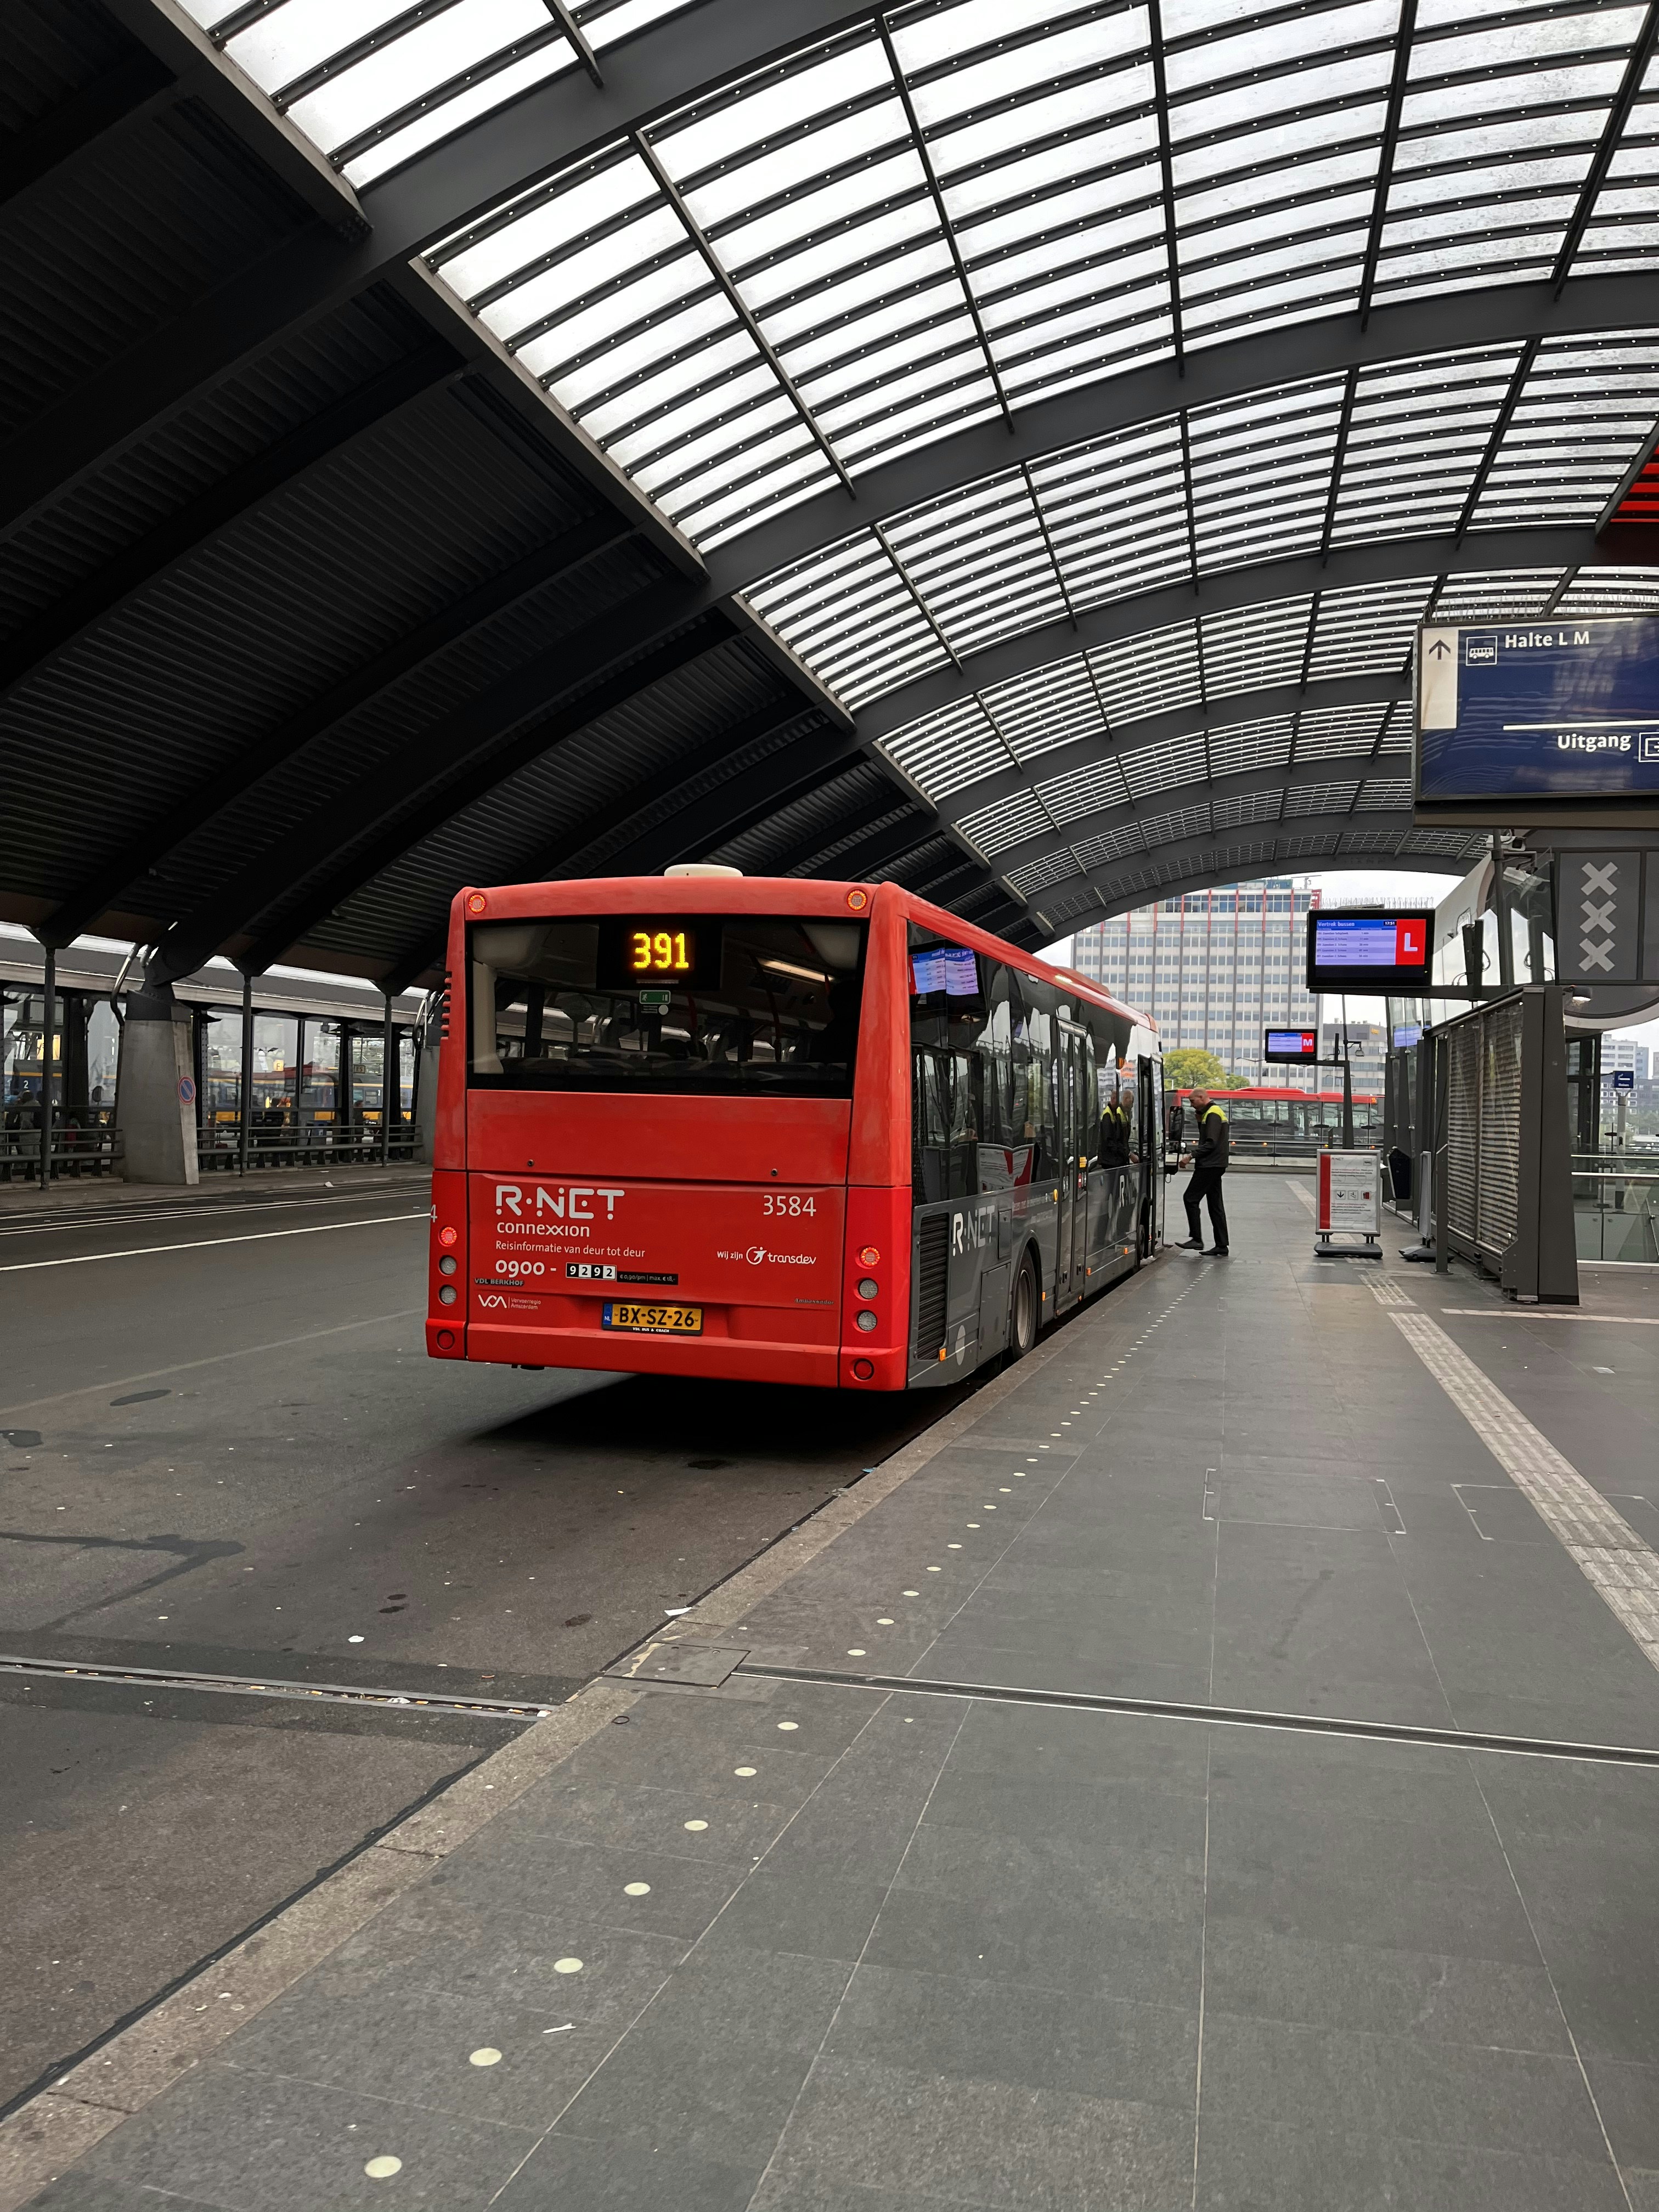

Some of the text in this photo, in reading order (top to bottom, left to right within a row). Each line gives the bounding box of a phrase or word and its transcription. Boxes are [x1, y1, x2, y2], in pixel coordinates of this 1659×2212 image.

[1505, 631, 1590, 648] Halte L M
[1558, 733, 1632, 752] Uitgang
[1404, 932, 1418, 951] L
[633, 933, 689, 969] 391
[24, 1080, 29, 1089] 2
[763, 1195, 816, 1216] 3584
[496, 1222, 590, 1237] connexxion
[495, 1240, 645, 1257] Reisinformatie van deur tot deur
[717, 1251, 743, 1261] Wij zijn
[768, 1252, 816, 1265] transdev
[495, 1260, 545, 1278] 0900
[568, 1265, 614, 1278] 9292
[619, 1307, 695, 1327] BX-SZ-26
